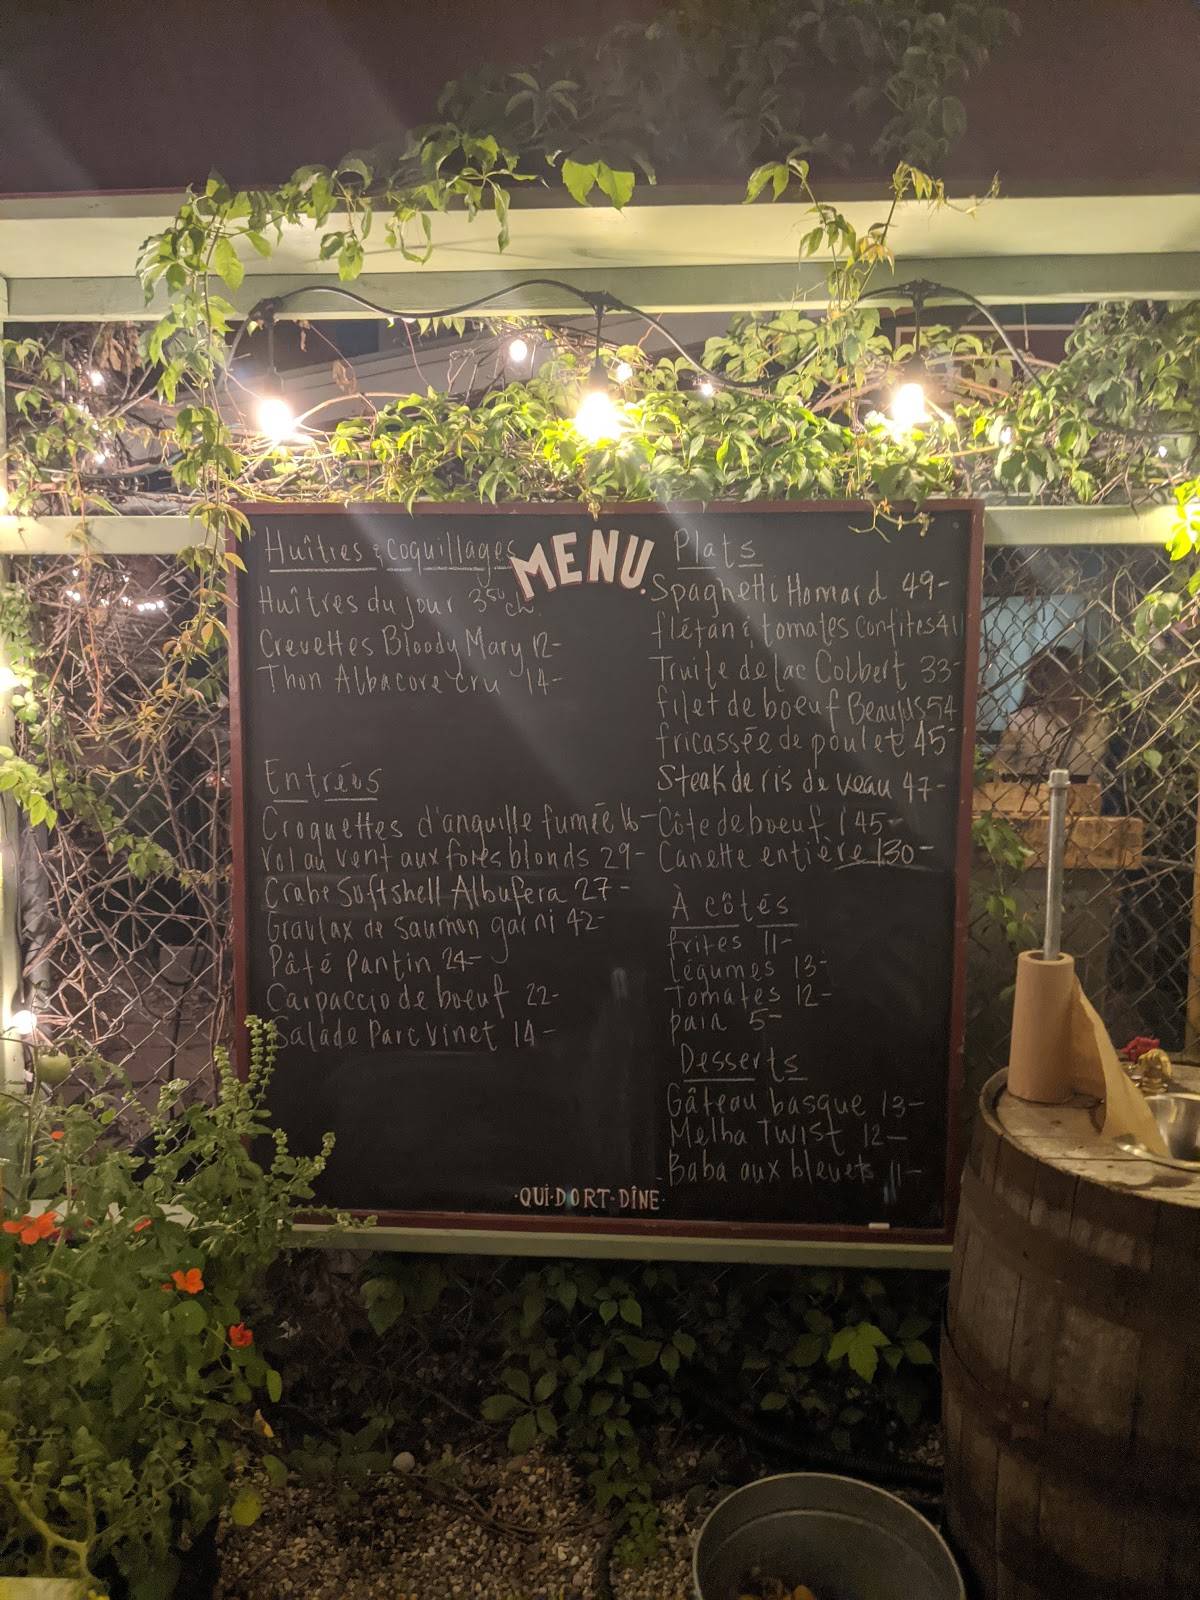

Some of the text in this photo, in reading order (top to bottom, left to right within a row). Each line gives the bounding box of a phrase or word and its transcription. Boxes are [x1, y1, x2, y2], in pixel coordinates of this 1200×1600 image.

[265, 527, 364, 565] Huîtres
[386, 530, 515, 588] Coquillages
[674, 528, 755, 569] Plats
[258, 584, 358, 617] Huîtres
[367, 586, 396, 616] du
[401, 592, 453, 630] jour
[650, 573, 778, 618] Spaghetti
[787, 572, 887, 607] Homard
[763, 612, 849, 648] tomates
[260, 628, 374, 659] Crevettes
[382, 624, 461, 676] Bloody
[465, 626, 523, 678] Mary
[648, 650, 728, 691] Truite
[739, 656, 768, 682] de
[815, 649, 908, 691] Colbert
[256, 663, 321, 695] Thon
[334, 664, 442, 696] Albacore
[727, 690, 757, 719] de
[655, 721, 773, 760] fricassée
[779, 725, 803, 750] de
[810, 722, 906, 768] poulet
[657, 763, 727, 798] Steak
[731, 760, 754, 792] de
[760, 765, 794, 793] ris
[802, 768, 830, 794] de
[262, 805, 404, 848] Croquettes
[542, 802, 614, 841] fumée
[716, 807, 747, 836] de
[303, 855, 327, 872] au
[336, 845, 393, 871] vent
[400, 847, 439, 869] aux
[508, 836, 590, 871] blonds
[658, 840, 753, 873] Canette
[760, 834, 863, 872] entière
[265, 876, 330, 905] Crabe
[450, 874, 568, 915] Albufera
[671, 882, 791, 923] À côtés
[364, 920, 384, 940] de
[490, 908, 555, 964] garni
[268, 945, 333, 986] Pâté
[266, 983, 390, 1024] Carpaccio
[398, 984, 427, 1012] de
[663, 979, 782, 1010] Tomates
[272, 1015, 358, 1052] Salade
[680, 1042, 799, 1082] Desserts
[666, 1082, 757, 1118] Gâteau
[770, 1088, 867, 1128] basque
[669, 1117, 746, 1148] Melba
[667, 1157, 728, 1187] Baba
[740, 1160, 779, 1182] aux
